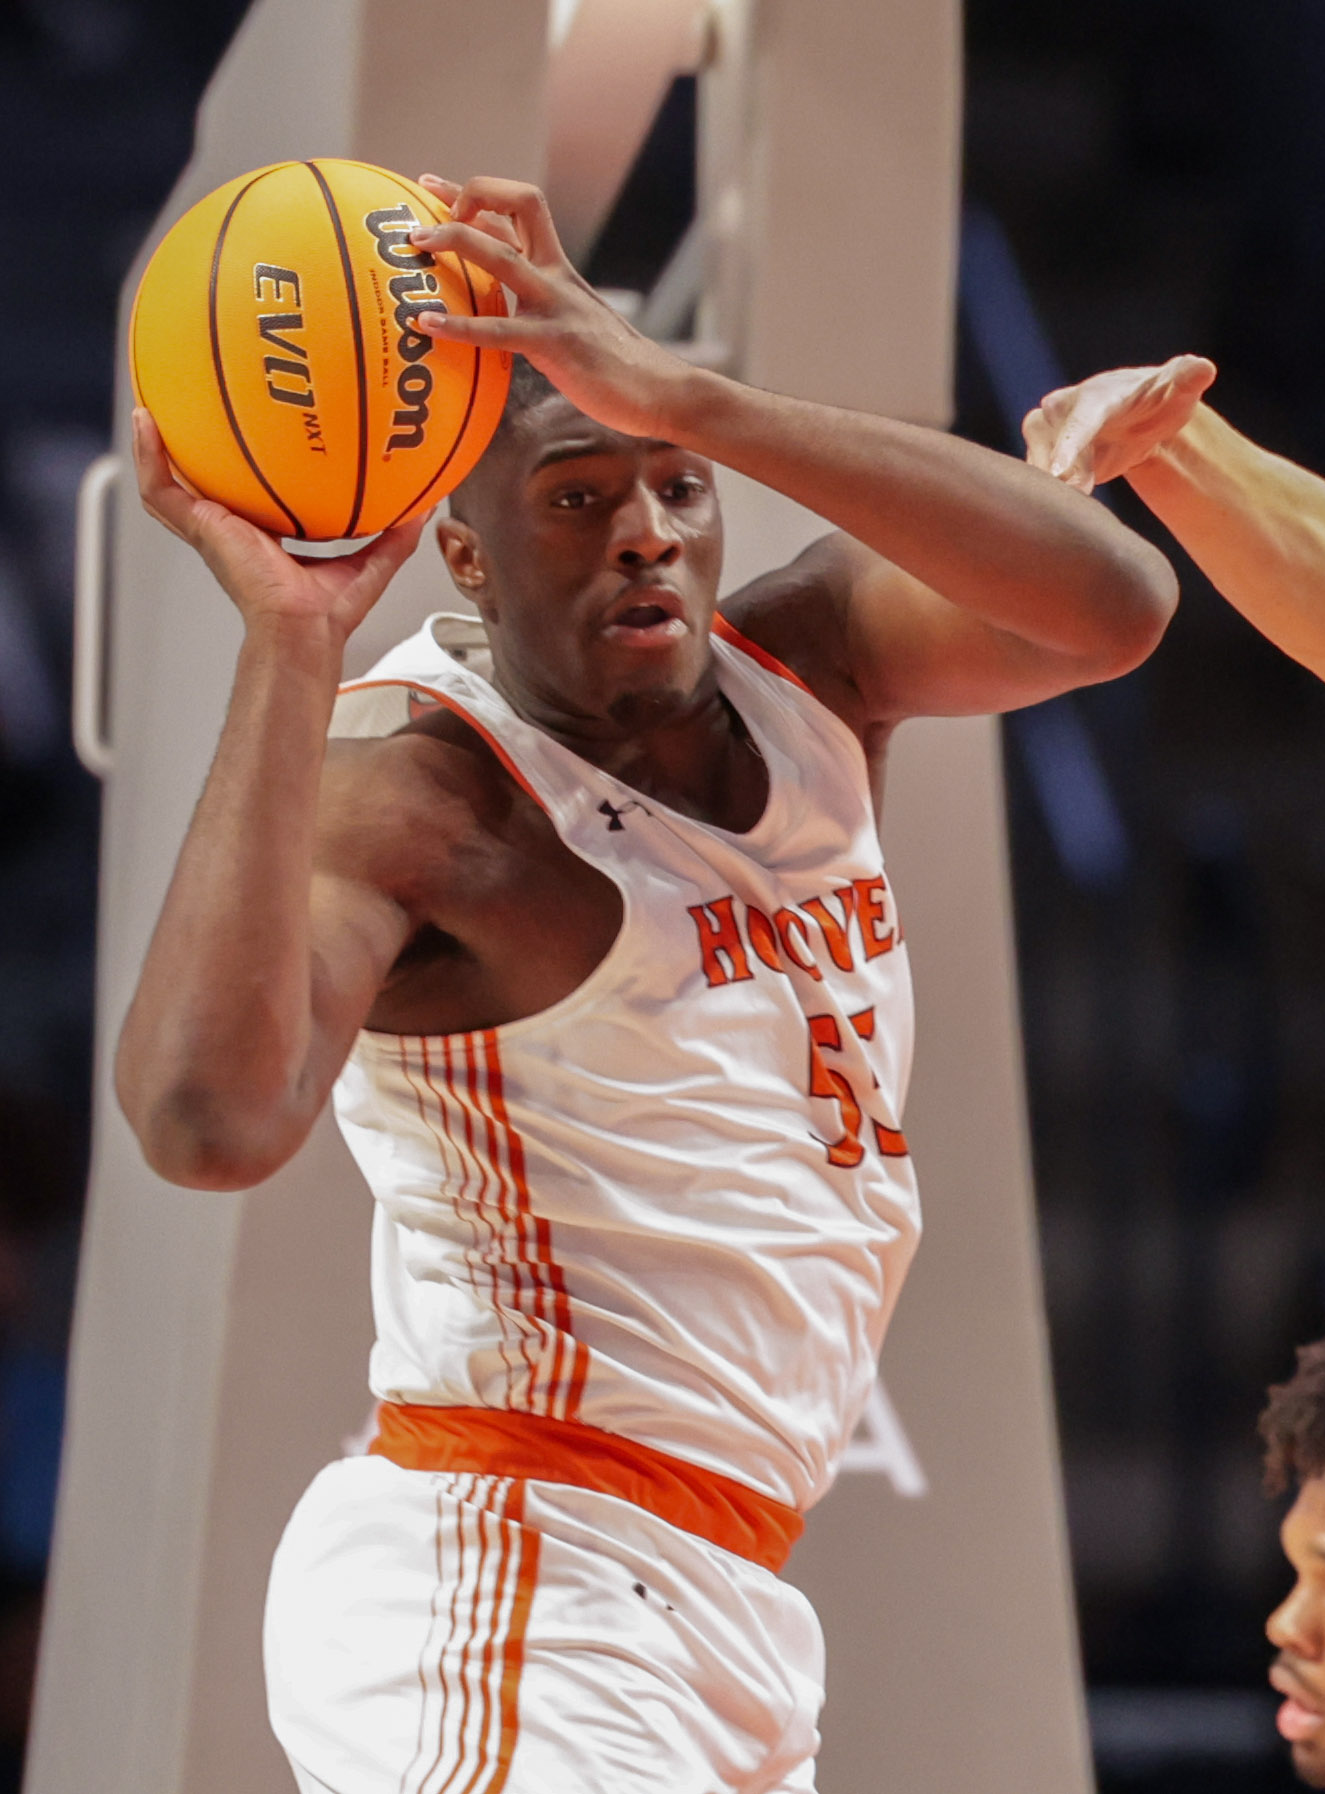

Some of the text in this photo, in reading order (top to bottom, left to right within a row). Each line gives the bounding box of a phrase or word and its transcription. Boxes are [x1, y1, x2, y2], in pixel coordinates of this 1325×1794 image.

[253, 262, 327, 456] EVO NXT
[363, 202, 448, 455] Wilson
[369, 268, 391, 388] INDOOR GAME BALL
[687, 873, 904, 988] HOOVE
